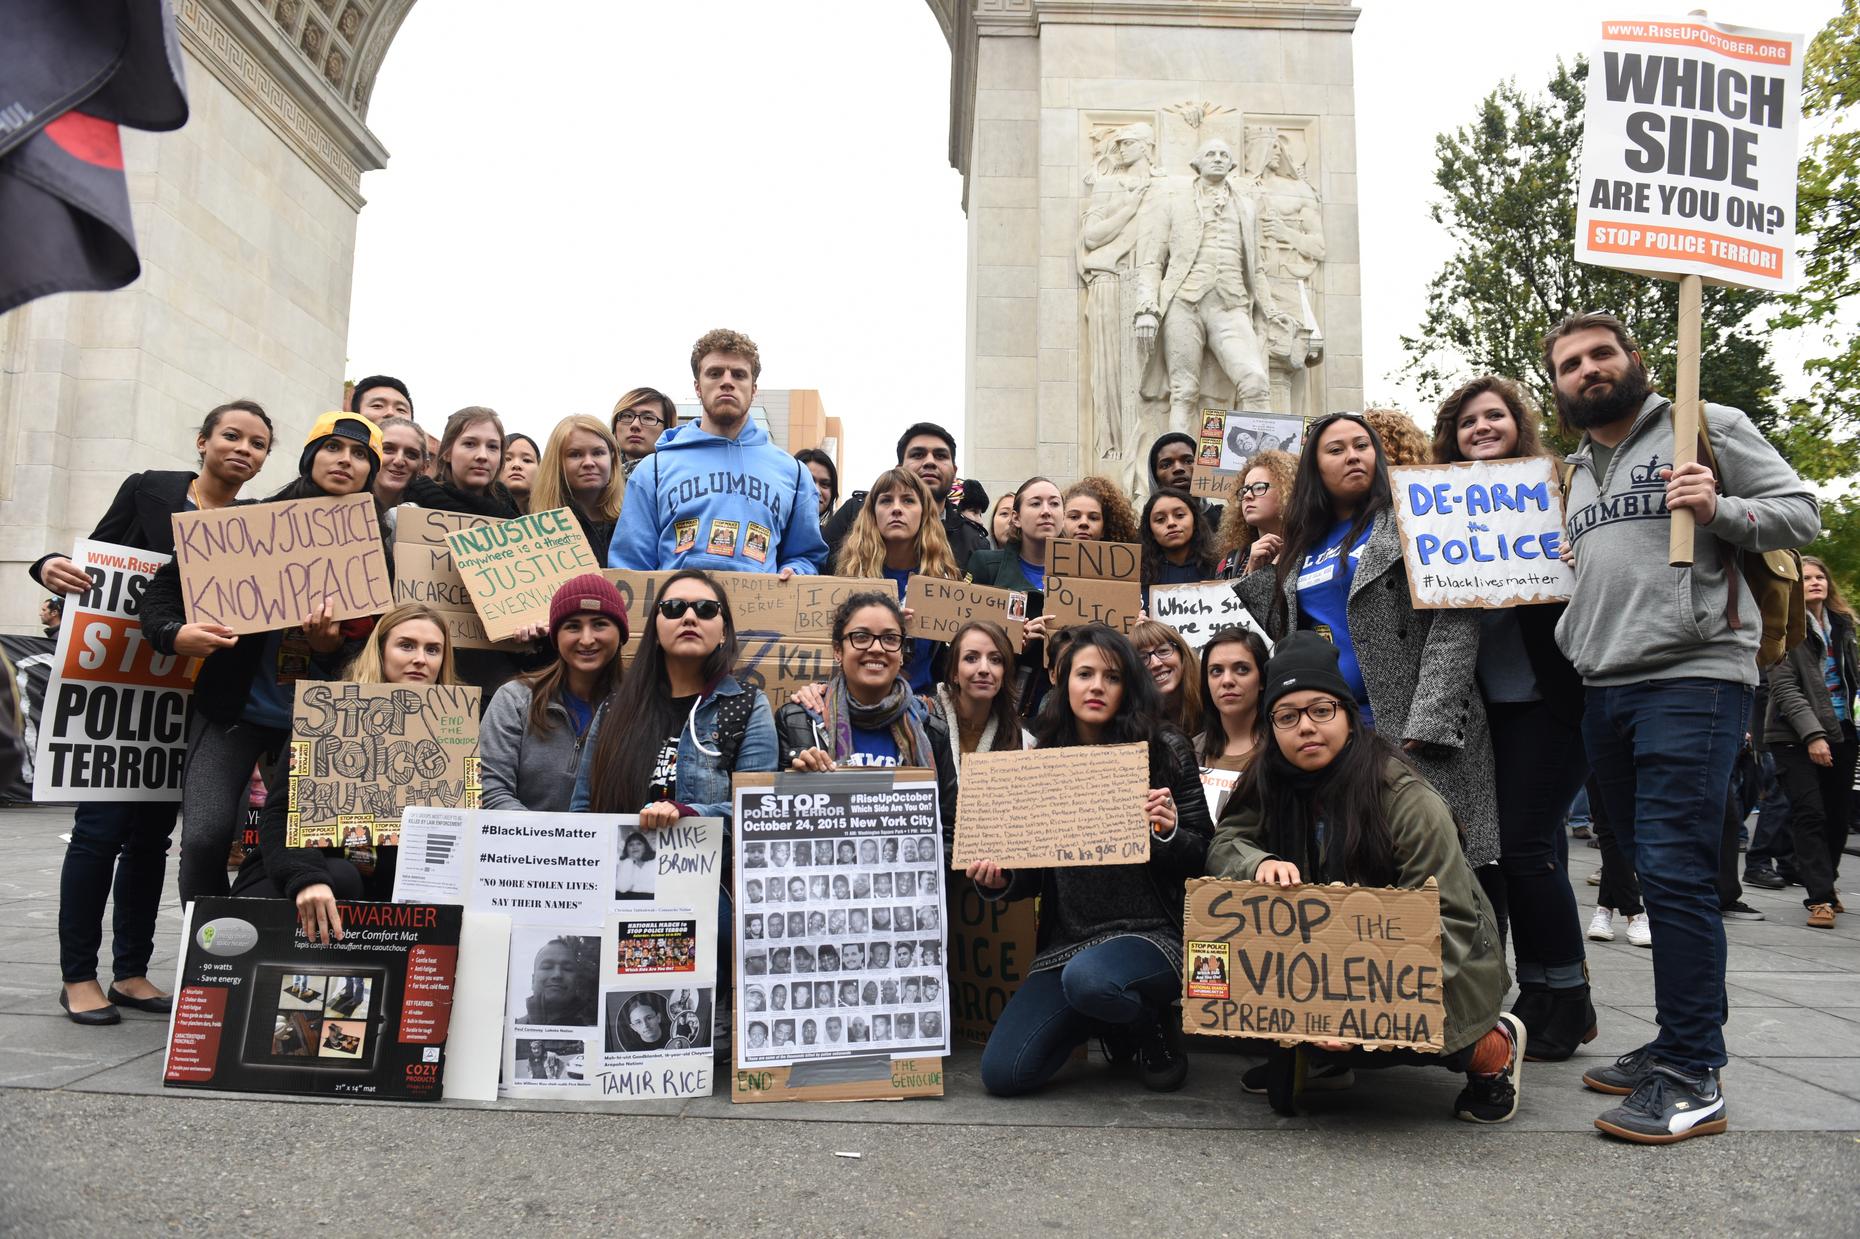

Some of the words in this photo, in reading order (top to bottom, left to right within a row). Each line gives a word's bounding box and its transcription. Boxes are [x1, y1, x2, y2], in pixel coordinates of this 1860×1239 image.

[1603, 50, 1785, 129] WHICH
[1624, 111, 1759, 191] SIDE
[1589, 178, 1651, 214] ARE
[1658, 184, 1720, 222] YOU
[1726, 196, 1785, 235] ON?
[1595, 226, 1641, 248] STOP
[1645, 231, 1706, 254] POLICE
[1710, 239, 1777, 270] TERROR!
[667, 471, 782, 526] COLUMBIA
[1408, 481, 1550, 516] DE-ARM
[178, 512, 276, 564] KNOW
[278, 500, 380, 553] JUSTICE
[448, 509, 573, 557] INJUSTICE
[458, 550, 515, 569] anywhere
[518, 540, 531, 554] is
[534, 541, 544, 550] a
[543, 533, 571, 550] threat
[1052, 541, 1136, 578] END
[1416, 531, 1561, 566] POLICE
[475, 544, 594, 598] JUSTICE
[79, 566, 150, 616] RIS
[187, 570, 286, 627] KNOW
[285, 549, 389, 621] PEACE
[397, 579, 471, 606] INCARCE
[925, 583, 1007, 611] ENOUGH
[957, 606, 973, 618] IS
[1045, 576, 1136, 635] POLICE
[1157, 597, 1213, 617] Which
[760, 794, 831, 812] STOP
[850, 792, 933, 805] #RiseUpOctober
[851, 805, 873, 814] Which
[874, 804, 889, 813] Side
[890, 804, 903, 812] Are
[904, 803, 919, 812] You
[919, 802, 932, 811] On?
[743, 808, 790, 819] POLICE
[793, 806, 845, 818] TERROR
[743, 820, 792, 832] October
[795, 819, 815, 831] 24,
[817, 818, 847, 830] 2015
[850, 816, 877, 828] New
[880, 815, 908, 827] York
[910, 813, 934, 828] City
[481, 824, 597, 839] #BlackLivesMatter
[658, 824, 706, 850] MIKE
[479, 853, 600, 867] #NativeLivesMatter
[658, 850, 717, 876] BROWN
[499, 878, 525, 889] MORE
[527, 879, 564, 890] STOLEN
[566, 880, 598, 891] LIVES:
[491, 898, 511, 907] SAY
[512, 898, 542, 909] THEIR
[544, 899, 583, 910] NAMES"
[1207, 890, 1332, 944] STOP
[1352, 914, 1405, 942] THE
[361, 929, 398, 942] Comfort
[400, 930, 418, 942] Mat
[201, 974, 217, 982] Save
[218, 975, 242, 986] energy
[203, 963, 213, 972] 90
[213, 963, 233, 971] watts
[1238, 948, 1442, 1005] VIOLENCE
[1200, 1000, 1296, 1033] SPREAD
[1303, 1011, 1332, 1035] THE
[1338, 1008, 1431, 1043] ALOHA
[406, 1064, 439, 1076] COZY
[895, 1060, 918, 1072] THE
[363, 1085, 377, 1093] mat
[595, 1071, 655, 1095] TAMIR
[663, 1069, 708, 1096] RICE
[737, 1071, 773, 1092] END
[891, 1072, 942, 1088] GENOCIDE
